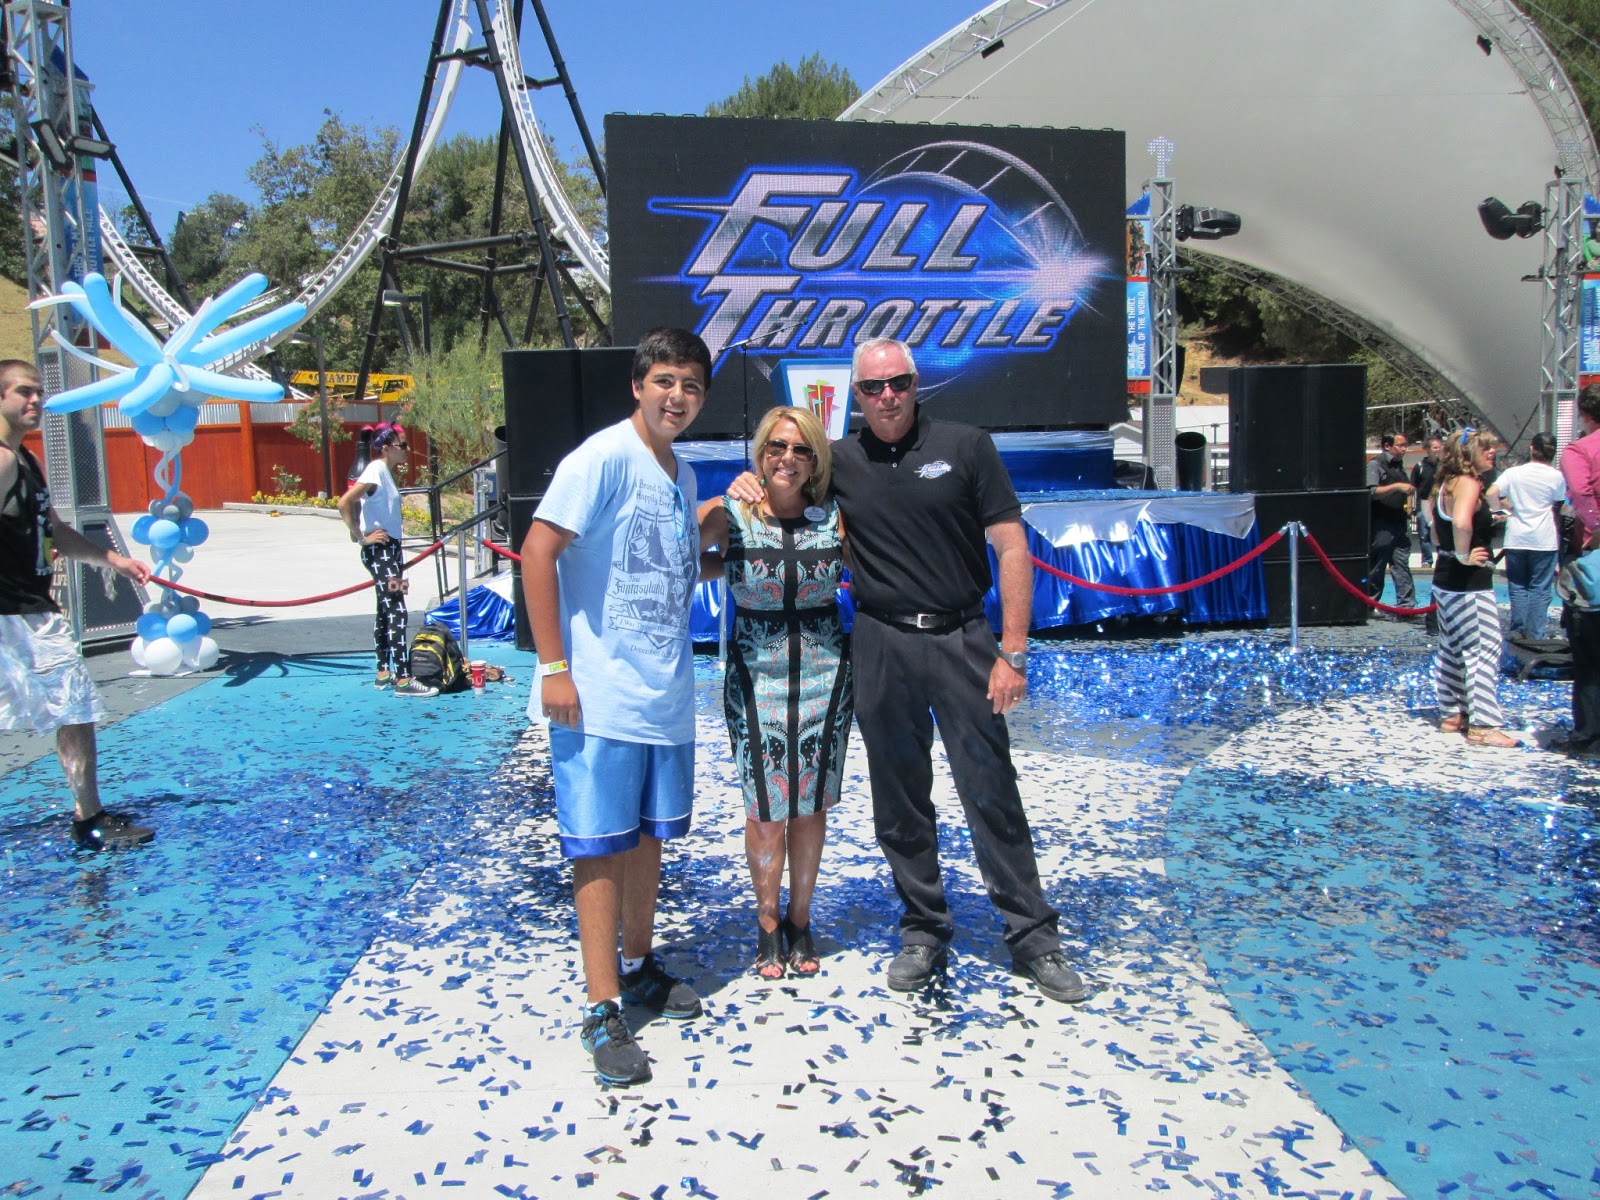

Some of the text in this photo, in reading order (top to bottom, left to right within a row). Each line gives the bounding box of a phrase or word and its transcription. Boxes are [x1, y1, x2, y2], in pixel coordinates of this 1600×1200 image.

[672, 171, 988, 277] FULL
[1128, 297, 1136, 319] THRILL
[698, 275, 1076, 364] THROTTLE
[1128, 321, 1136, 334] THE
[1138, 291, 1146, 370] CAPITAL OF THE WORLD
[1128, 357, 1136, 370] WE
[612, 576, 665, 597] Fantasyland
